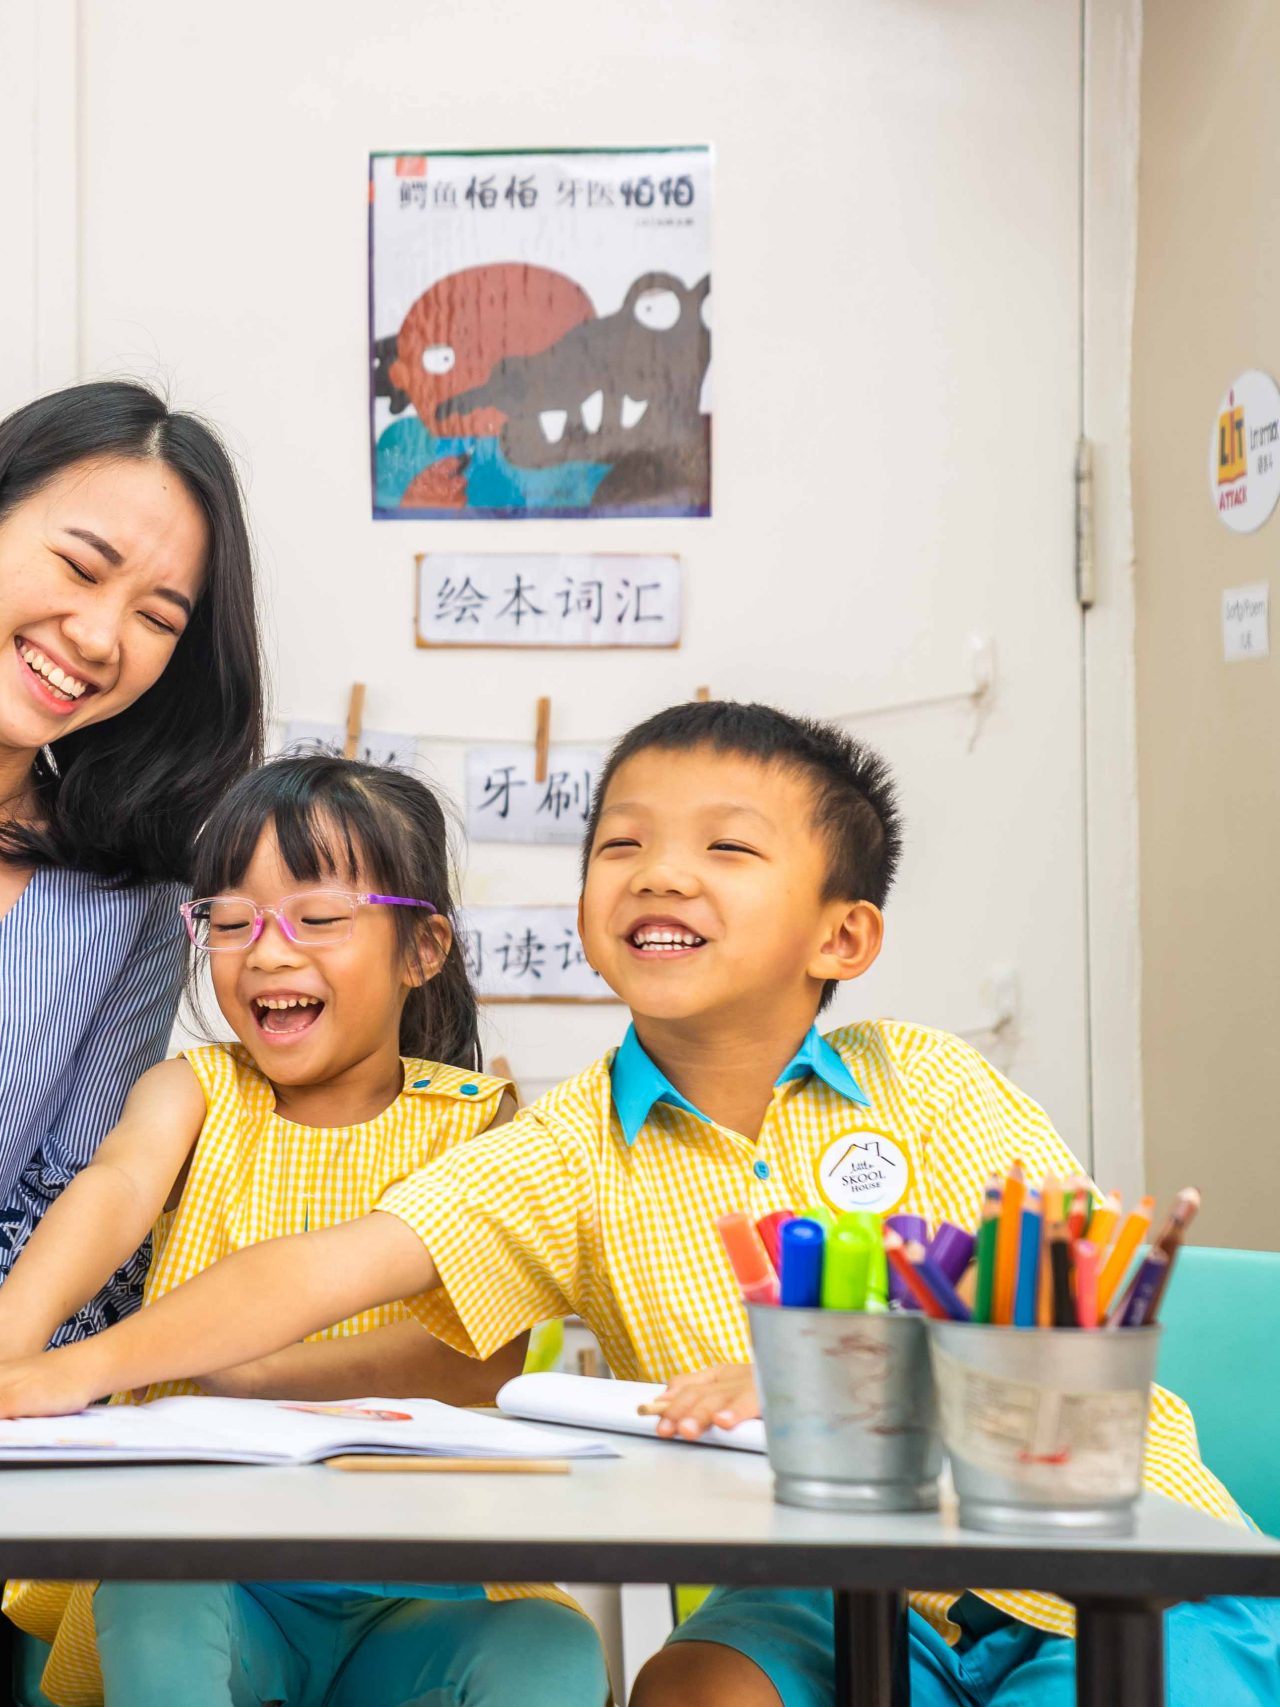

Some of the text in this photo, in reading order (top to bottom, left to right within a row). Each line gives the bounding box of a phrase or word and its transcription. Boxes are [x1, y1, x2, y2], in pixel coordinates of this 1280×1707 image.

[1219, 485, 1248, 512] ATTACK
[435, 573, 664, 626] 绘本词汇
[476, 765, 591, 821] 牙刷
[841, 1170, 886, 1186] SKOOL
[851, 1181, 881, 1193] HOUSE
